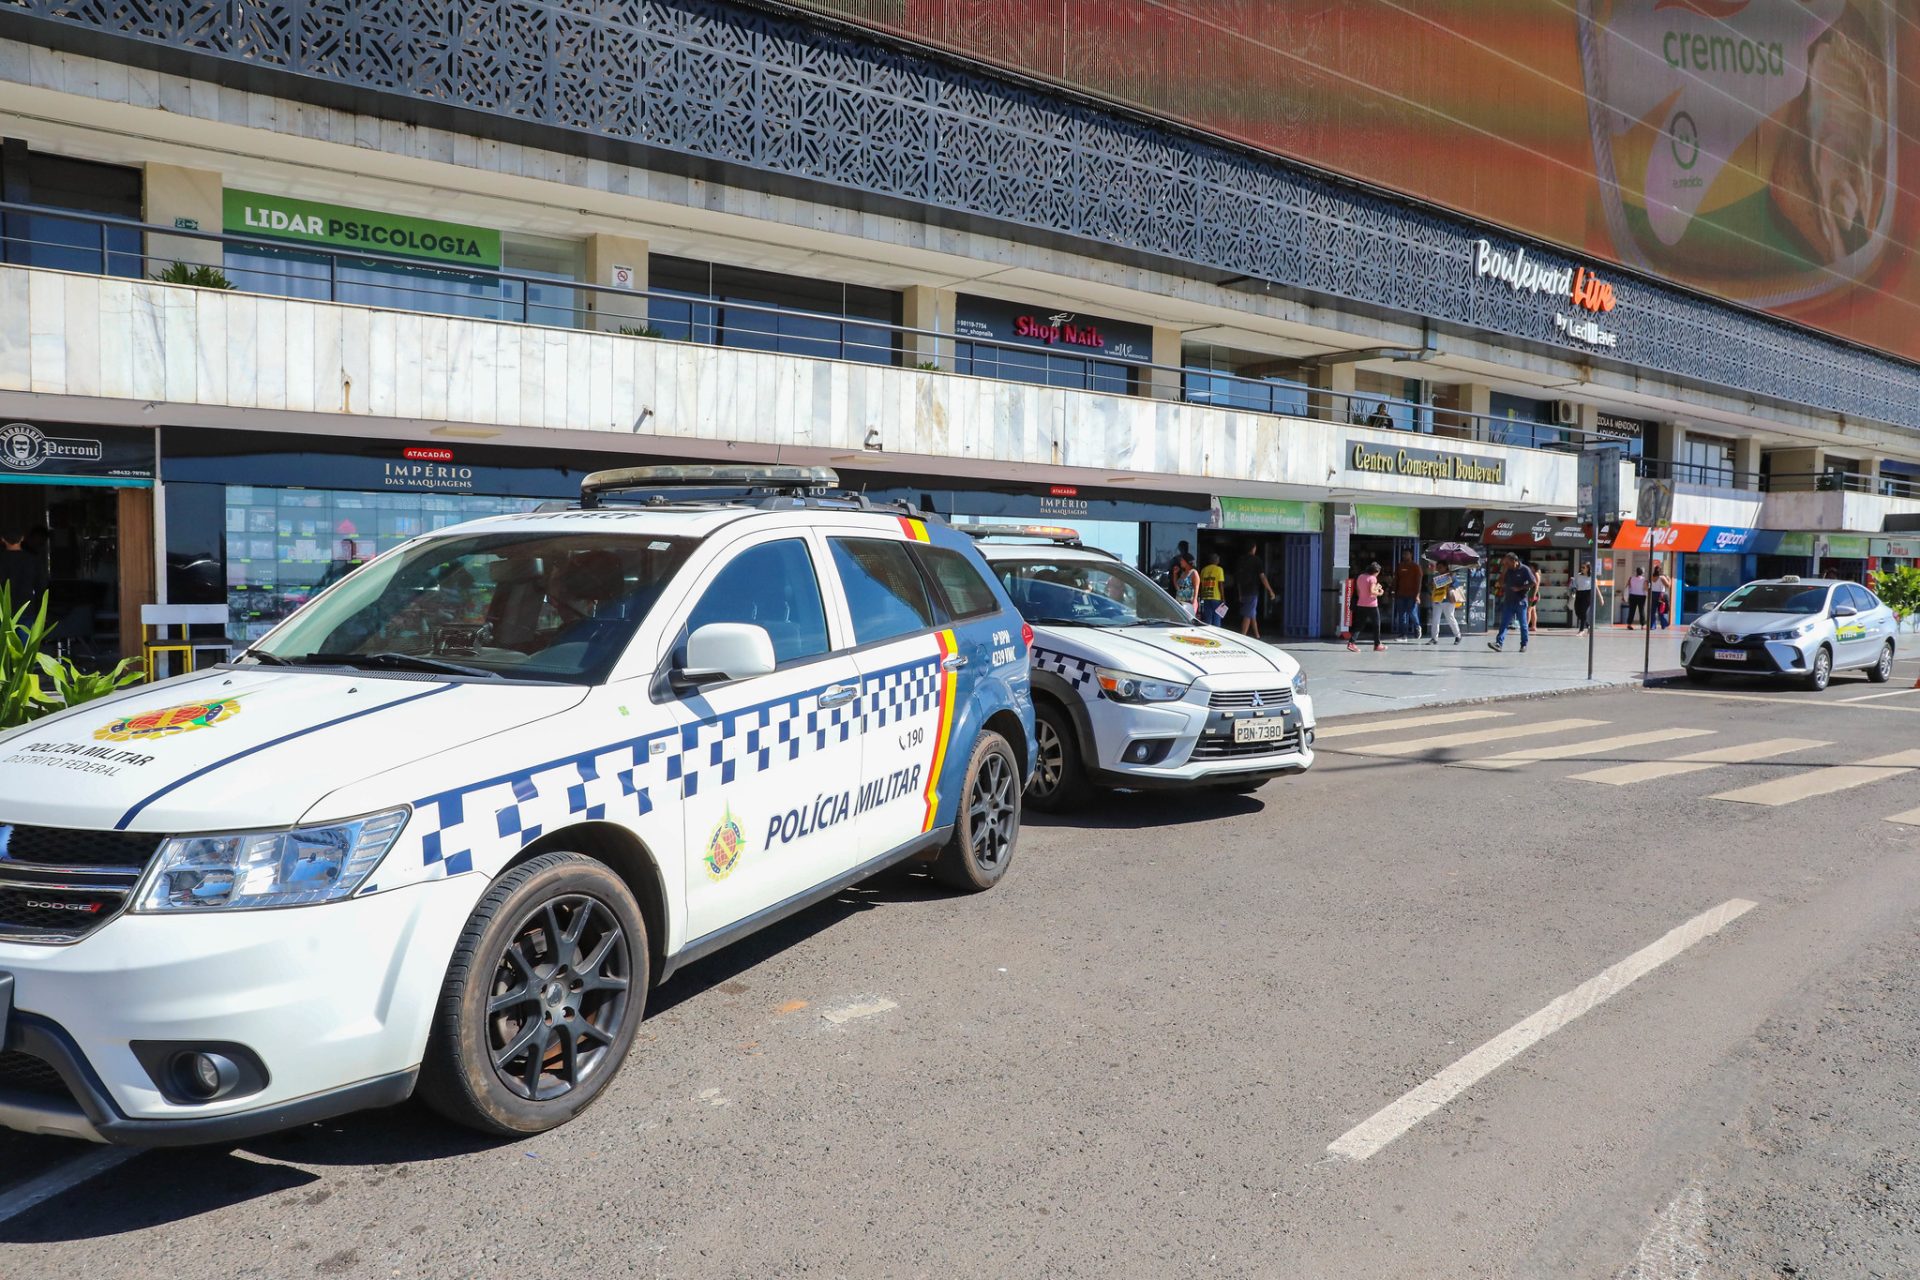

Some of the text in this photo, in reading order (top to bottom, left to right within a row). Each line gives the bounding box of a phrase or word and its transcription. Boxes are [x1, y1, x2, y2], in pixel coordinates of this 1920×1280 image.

[1663, 31, 1784, 76] cremosa
[244, 207, 324, 236] LIDAR
[328, 219, 482, 258] PSICOLOGIA
[1573, 267, 1617, 312] Live
[1016, 315, 1060, 344] Shop
[1556, 313, 1567, 330] By
[42, 441, 99, 456] Perroni
[407, 450, 451, 458] ATACADÃO
[385, 463, 472, 479] IMPÉRIO
[1355, 443, 1501, 482] Centro Comercial Boulevard
[407, 479, 472, 488] MAQUIAGENS
[1040, 497, 1088, 509] IMPÉRIO
[1715, 529, 1748, 548] agibank
[907, 727, 924, 749] 190
[2, 755, 122, 777] DISTRITO FEDERAL
[79, 746, 155, 767] MILITAR
[764, 763, 922, 851] POLÍCIA MILITAR
[26, 900, 92, 911] DODGE
